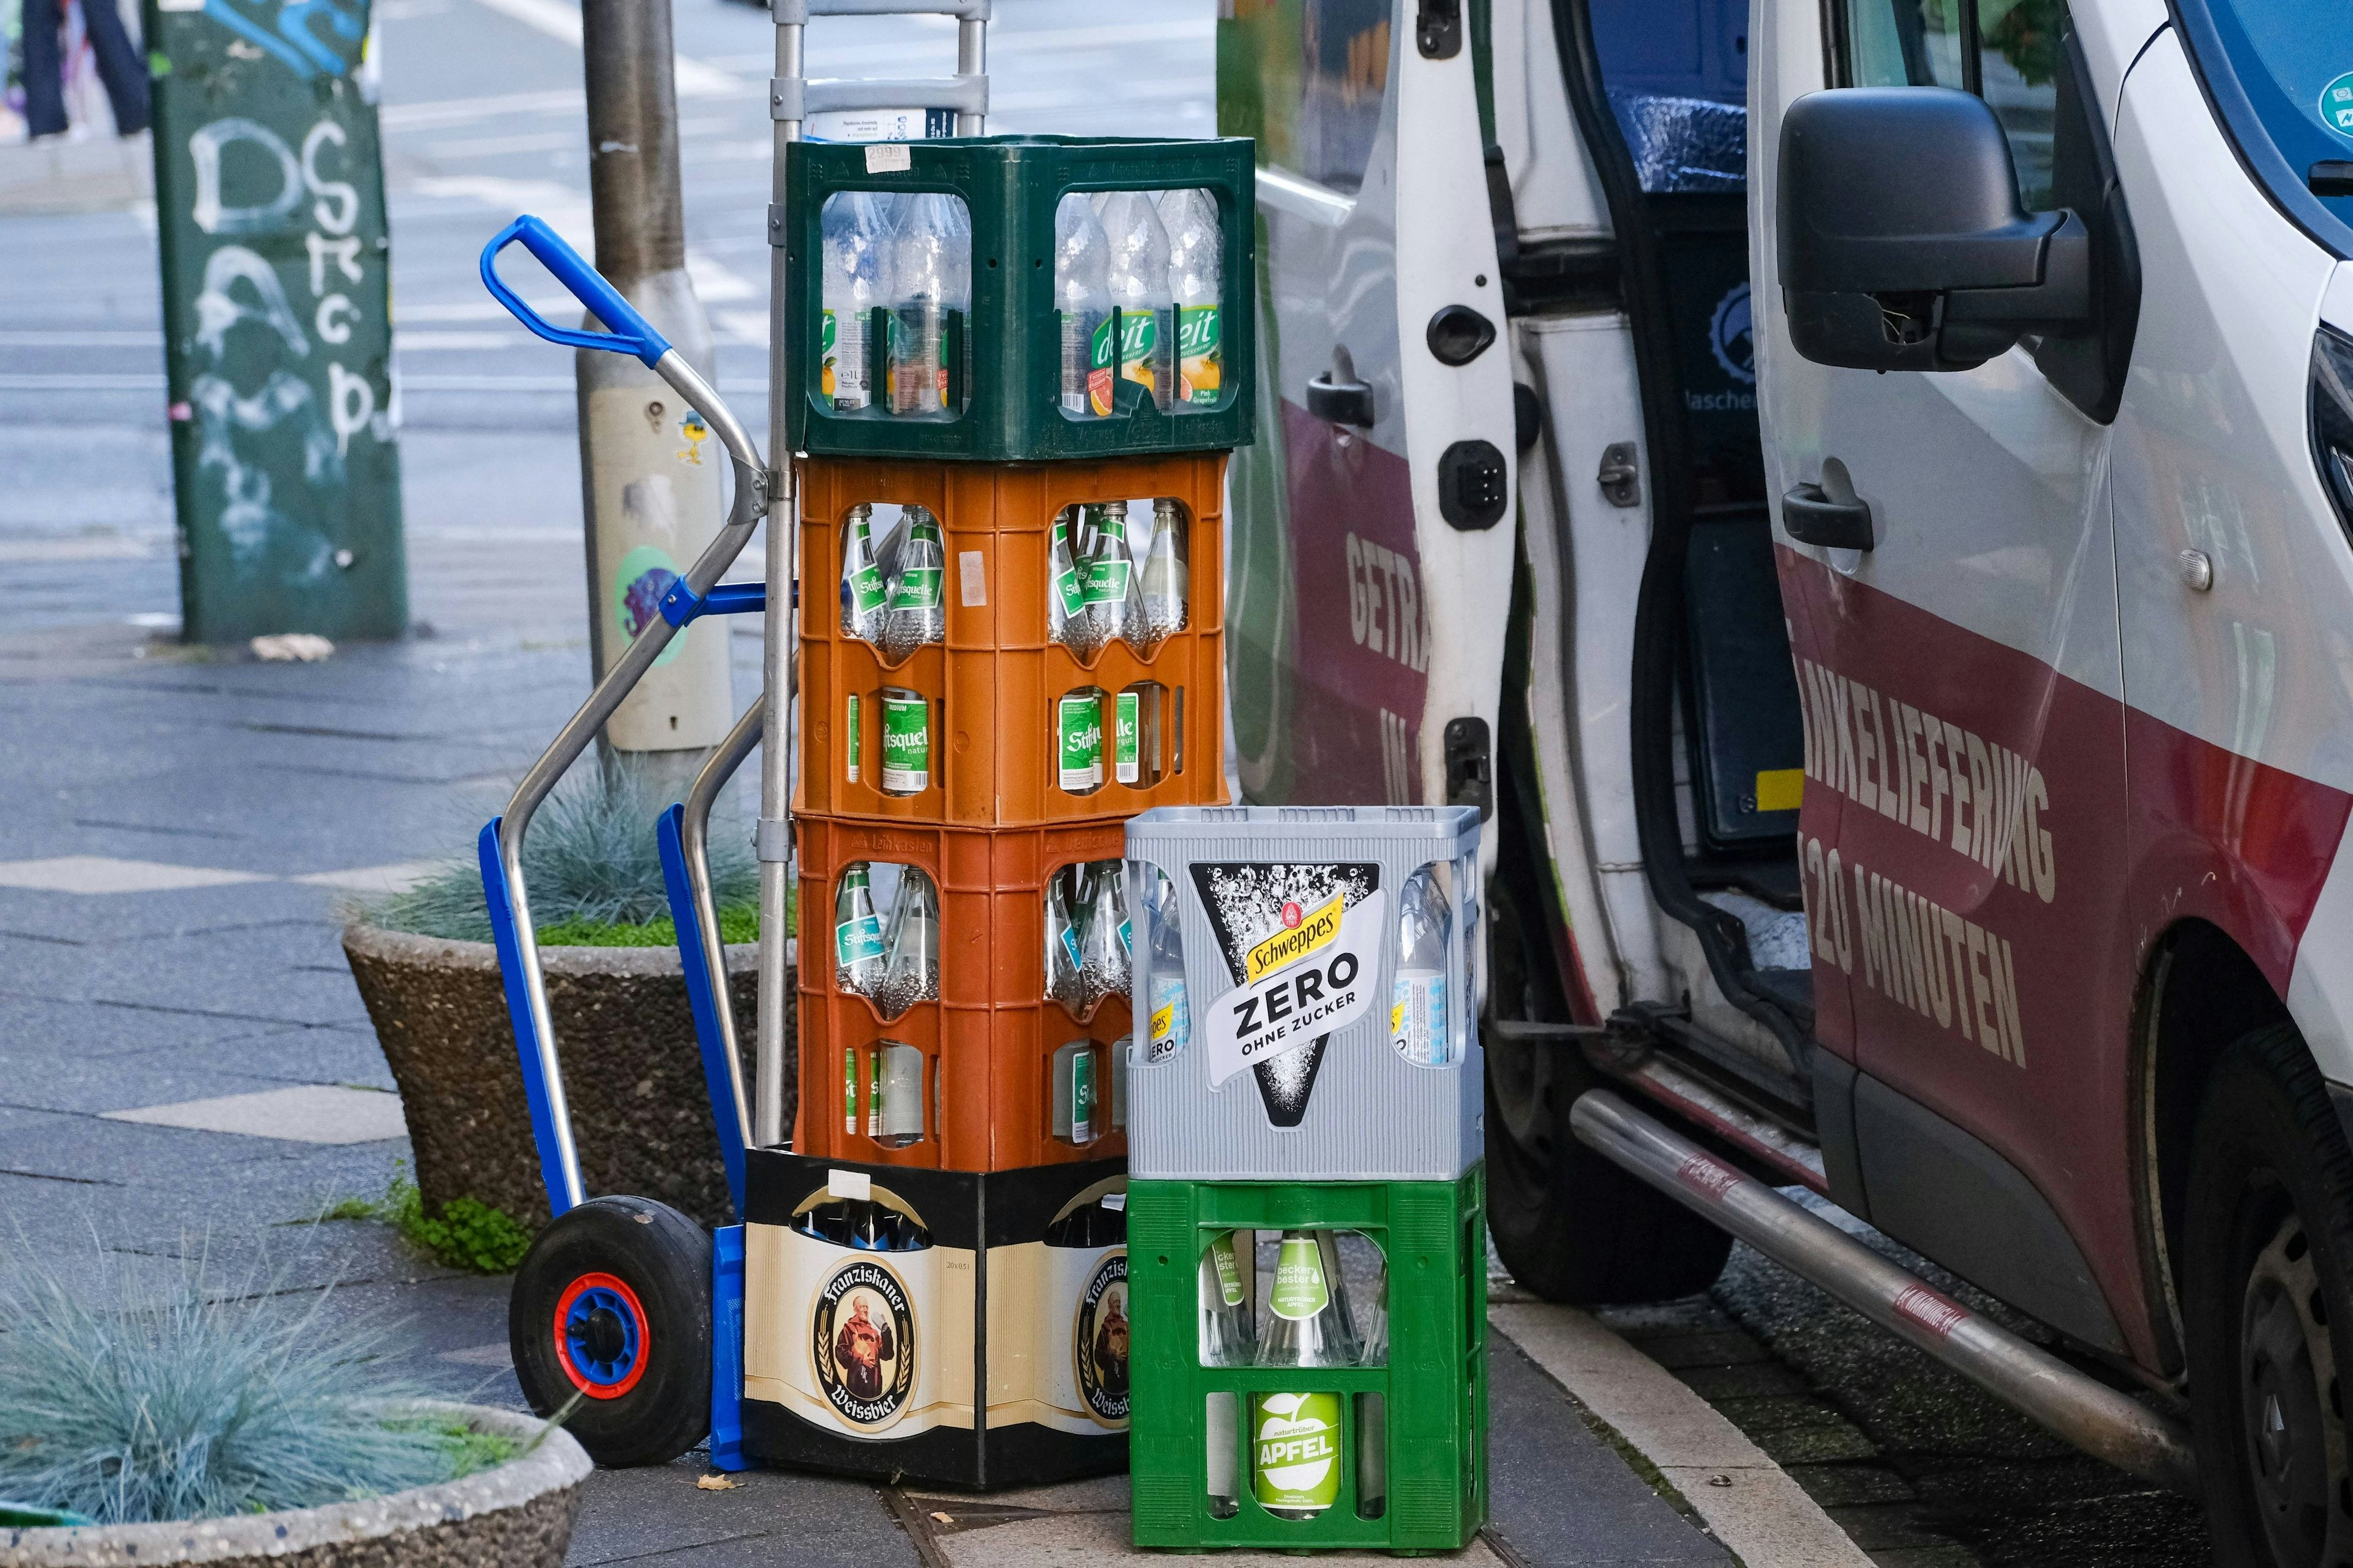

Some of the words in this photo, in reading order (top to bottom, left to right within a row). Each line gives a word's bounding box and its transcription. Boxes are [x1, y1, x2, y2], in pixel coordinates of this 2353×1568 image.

[868, 146, 901, 159] 2999
[1255, 912, 1334, 975] Schweppes
[1854, 863, 2027, 1069] MINUTEN
[1233, 952, 1359, 1040] ZERO
[1241, 1025, 1287, 1056] OHNE
[1291, 991, 1356, 1032] ZUCKER
[824, 1265, 905, 1313] Franziskaner
[1277, 1273, 1310, 1284] bester
[831, 1384, 896, 1420] Weissbier
[1259, 1435, 1334, 1466] APFEL
[1274, 1425, 1315, 1436] naturtrüber
